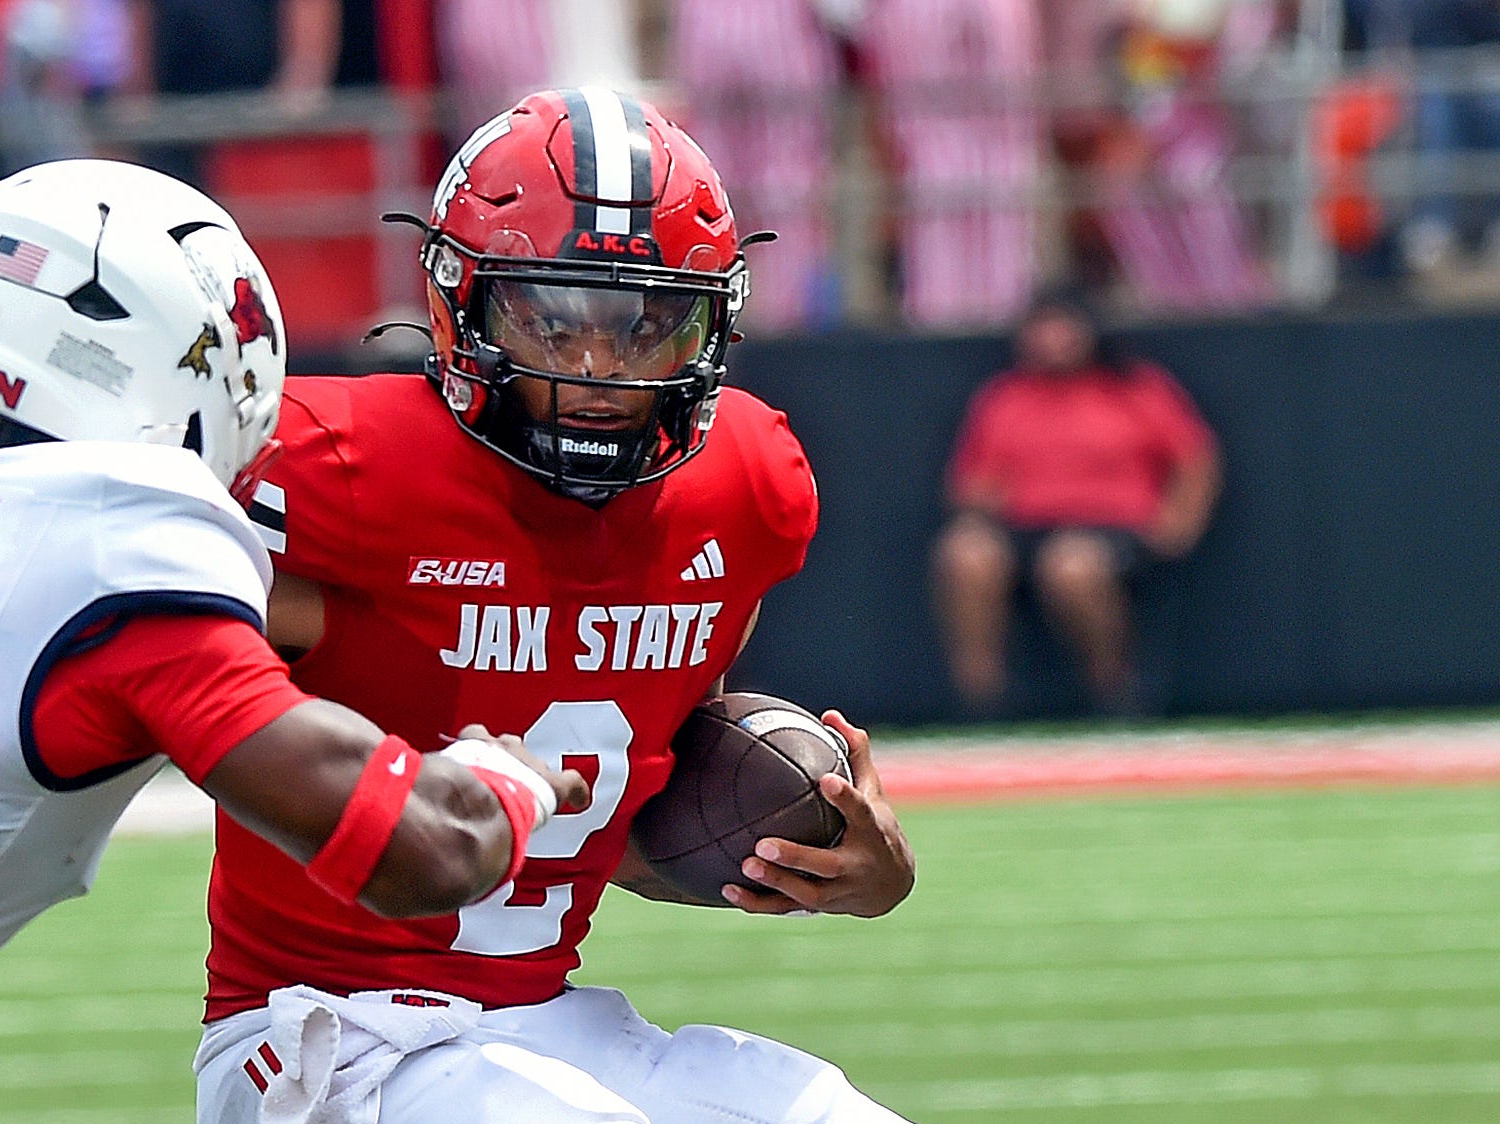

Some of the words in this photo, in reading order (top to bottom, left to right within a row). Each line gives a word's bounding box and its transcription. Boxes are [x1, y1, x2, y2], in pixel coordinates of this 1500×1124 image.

[561, 438, 619, 457] Riddell
[439, 603, 551, 671] JAX
[574, 601, 724, 671] STATE
[450, 700, 634, 956] 2
